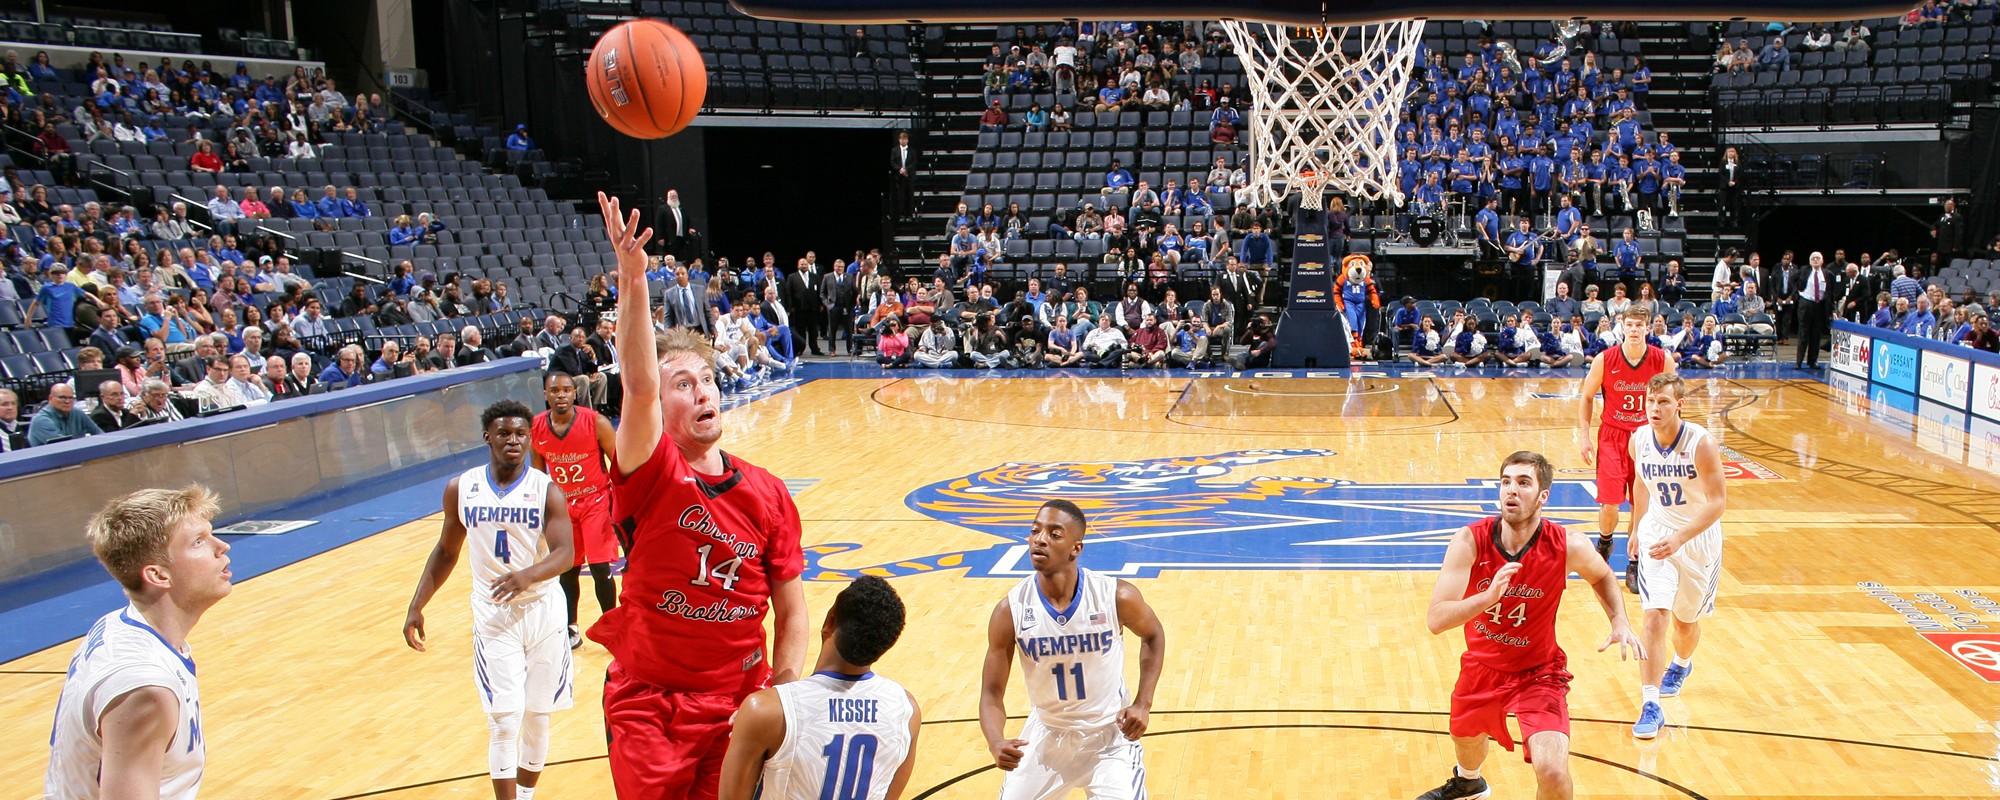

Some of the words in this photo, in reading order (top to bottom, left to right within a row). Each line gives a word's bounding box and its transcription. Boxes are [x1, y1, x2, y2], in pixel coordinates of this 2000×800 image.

[394, 75, 408, 84] 103
[1890, 353, 1914, 369] VERSANT
[1622, 394, 1644, 412] 31
[554, 463, 586, 484] 32
[1641, 462, 1698, 480] MEMPHIS
[1656, 482, 1688, 507] 32
[464, 506, 540, 530] MEMPHIS
[494, 530, 511, 564] 4
[690, 544, 743, 592] 14
[1476, 577, 1545, 599] Cistian
[1484, 602, 1527, 628] 44
[1016, 629, 1113, 663] MEMPHIS
[1051, 662, 1087, 701] 11
[828, 698, 878, 723] KESSEE
[820, 733, 878, 800] 10
